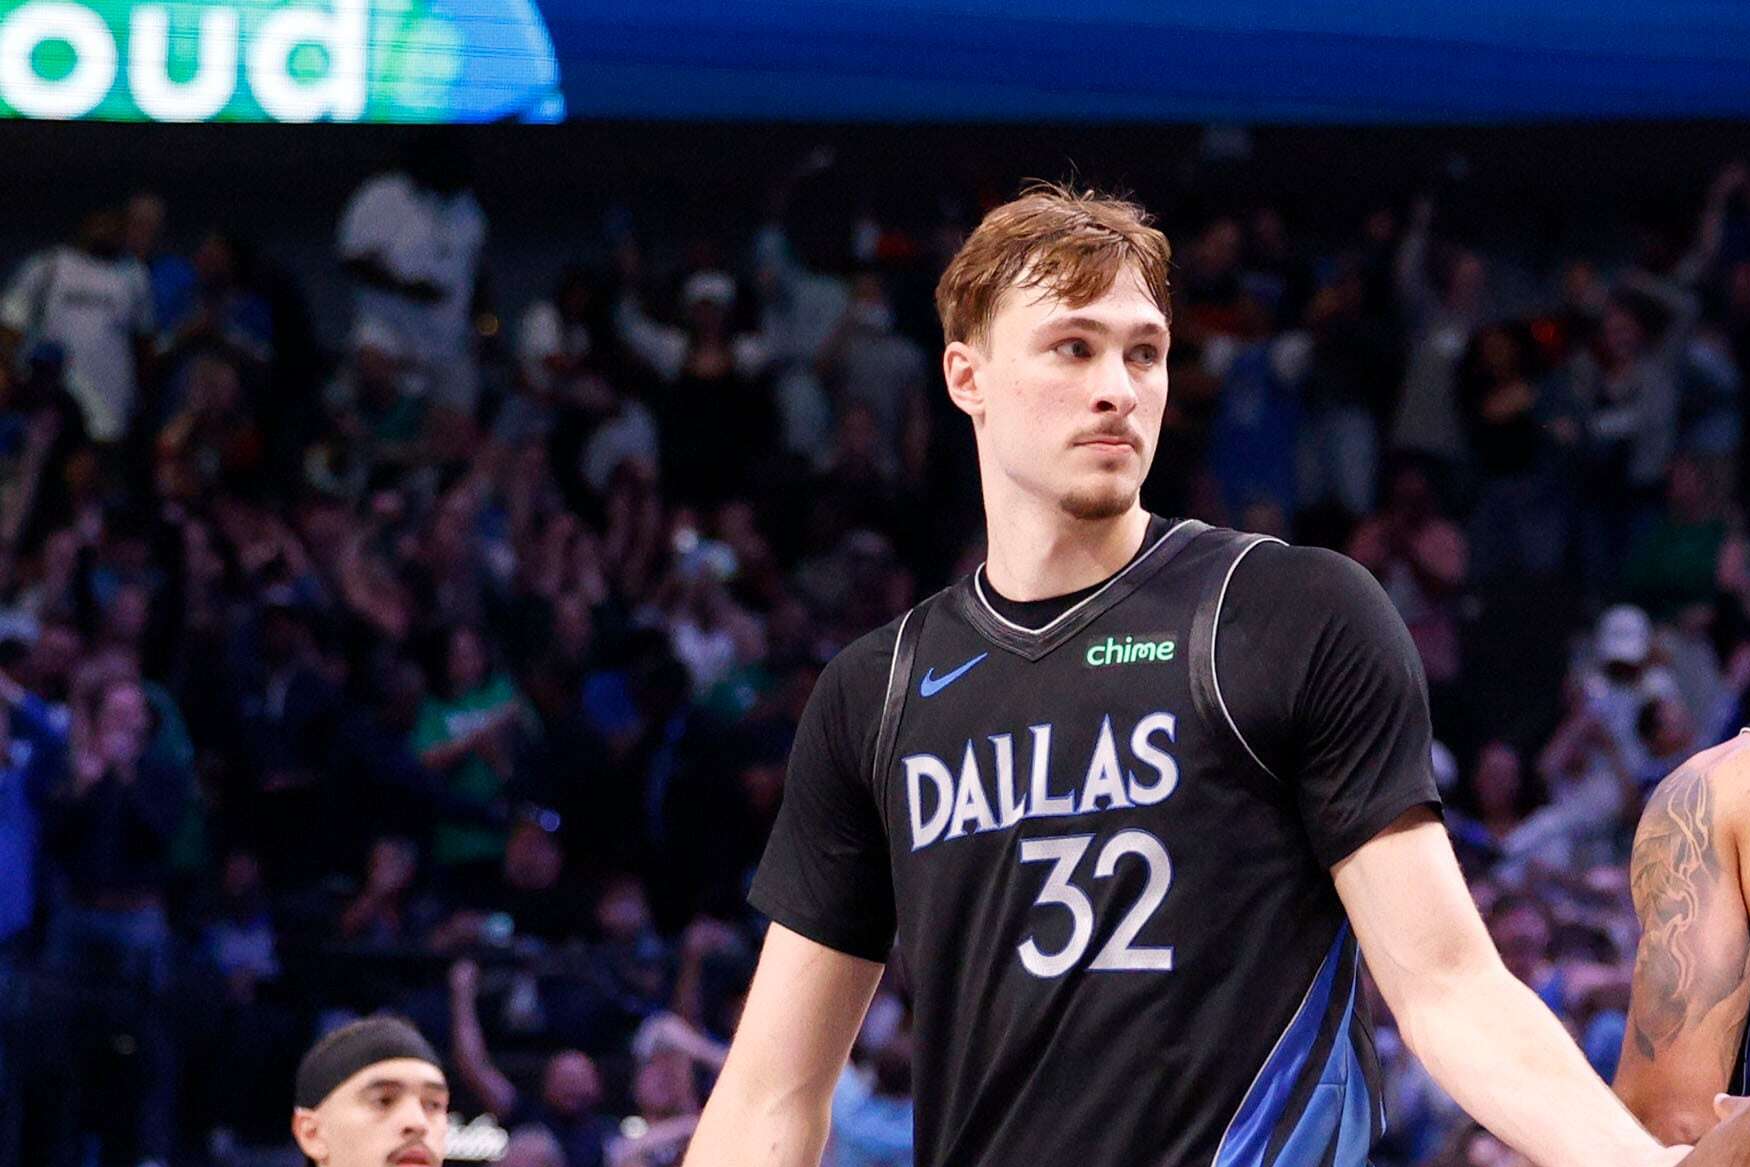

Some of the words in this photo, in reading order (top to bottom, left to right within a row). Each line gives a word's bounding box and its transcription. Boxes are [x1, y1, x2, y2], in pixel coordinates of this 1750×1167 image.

[1086, 636, 1175, 666] chime
[901, 711, 1180, 852] DALLAS
[1017, 828, 1175, 978] 32
